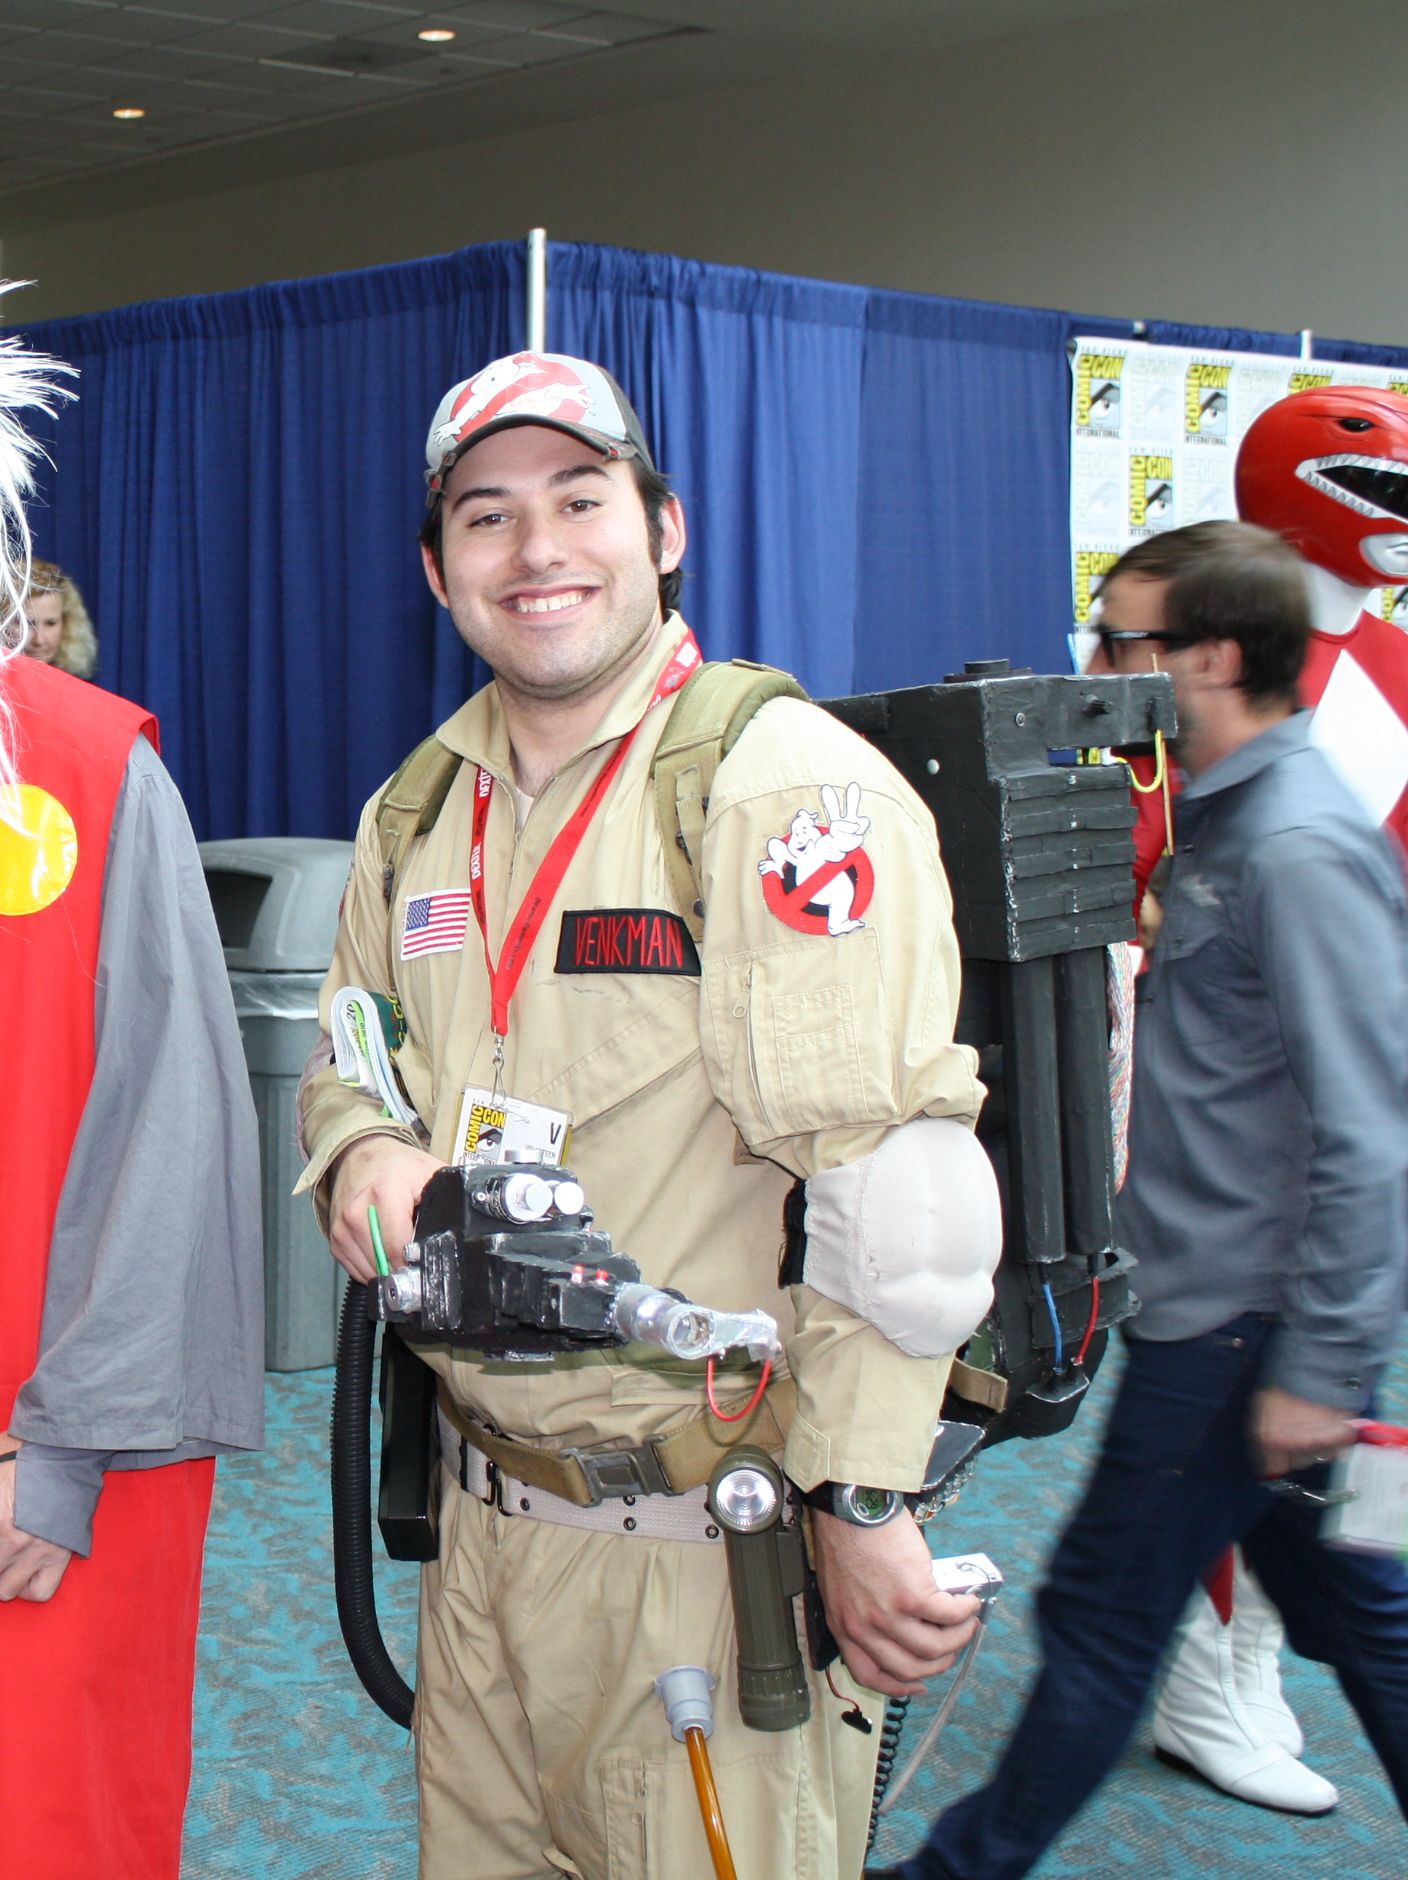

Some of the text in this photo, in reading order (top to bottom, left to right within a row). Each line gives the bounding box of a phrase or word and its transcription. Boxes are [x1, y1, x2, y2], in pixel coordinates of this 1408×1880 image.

[1076, 354, 1092, 426] COMIC
[1092, 356, 1125, 379] CON
[1201, 365, 1232, 388] CON
[1184, 363, 1201, 434] COMIC
[1129, 455, 1146, 526] COMIC
[1146, 456, 1173, 480] CON
[1075, 552, 1090, 623] COMIC
[575, 915, 684, 968] VENKMAN
[464, 1104, 484, 1153] COMIC
[483, 1107, 507, 1129] CON
[550, 1122, 561, 1145] V
